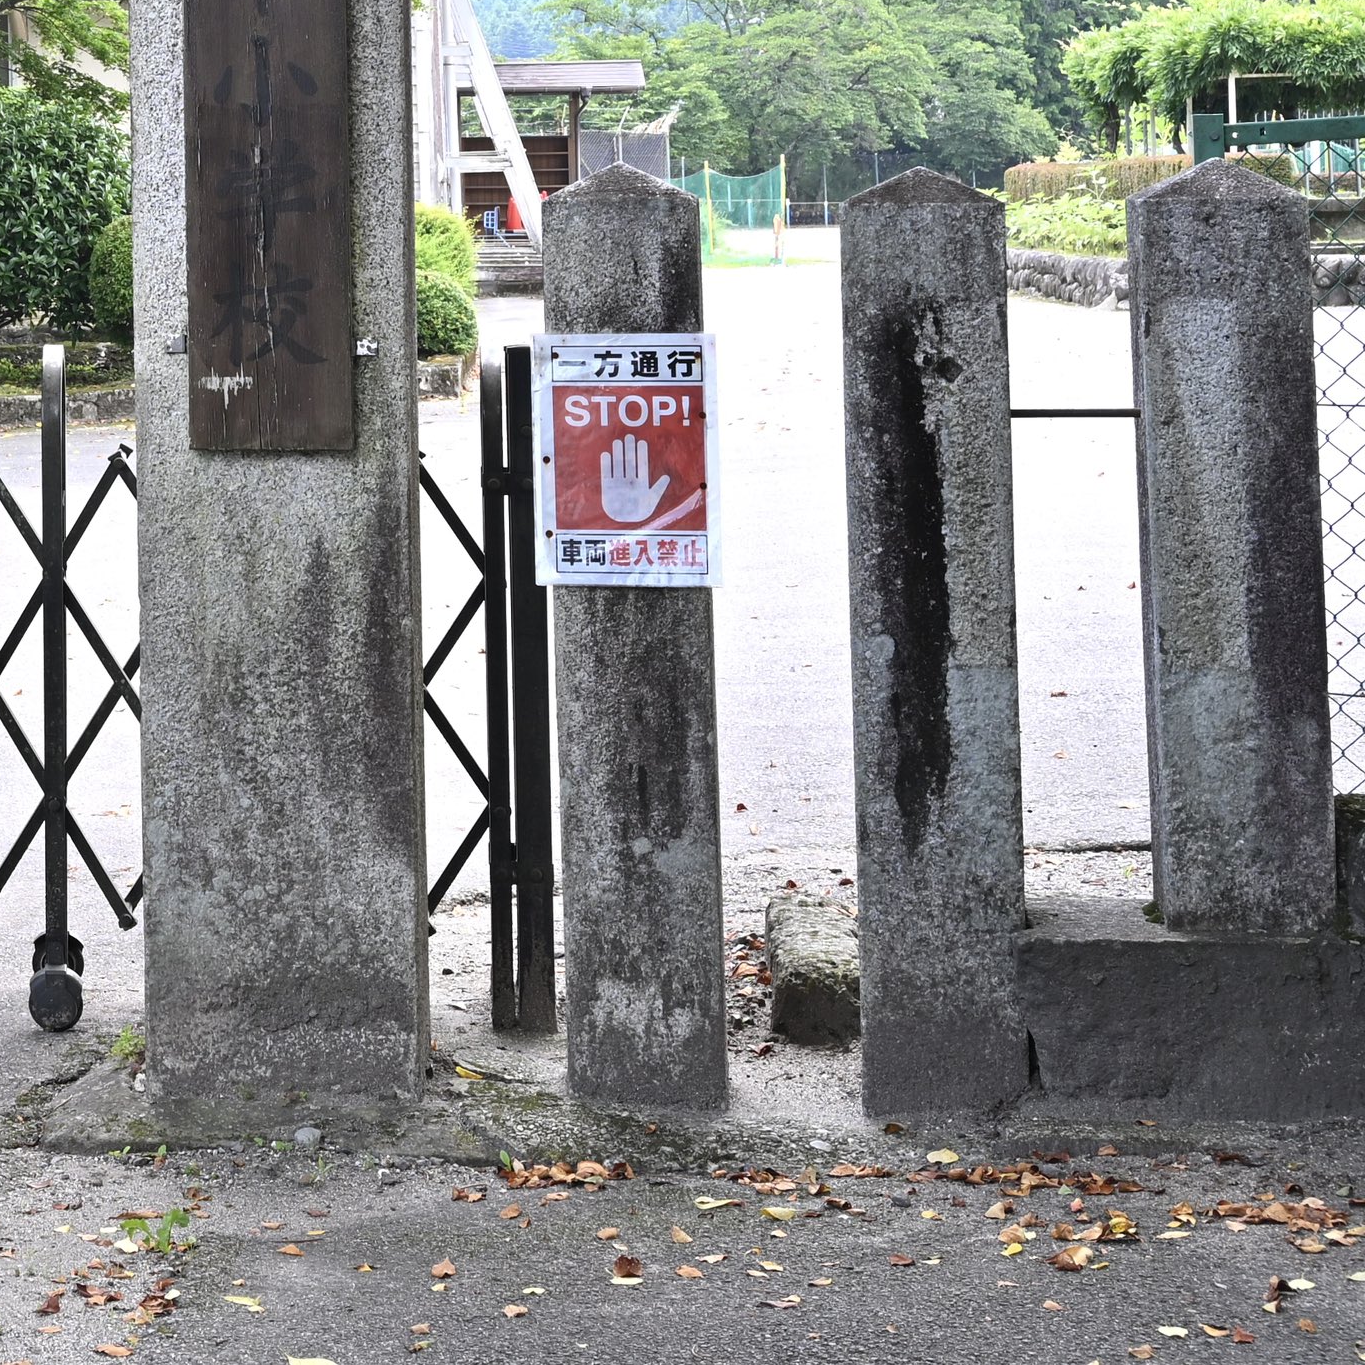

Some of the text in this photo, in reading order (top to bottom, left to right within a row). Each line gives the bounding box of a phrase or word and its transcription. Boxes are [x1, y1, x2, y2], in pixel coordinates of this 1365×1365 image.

[558, 350, 697, 378] 一方通行
[563, 394, 691, 427] STOP!
[560, 539, 705, 567] 車両進入禁止
